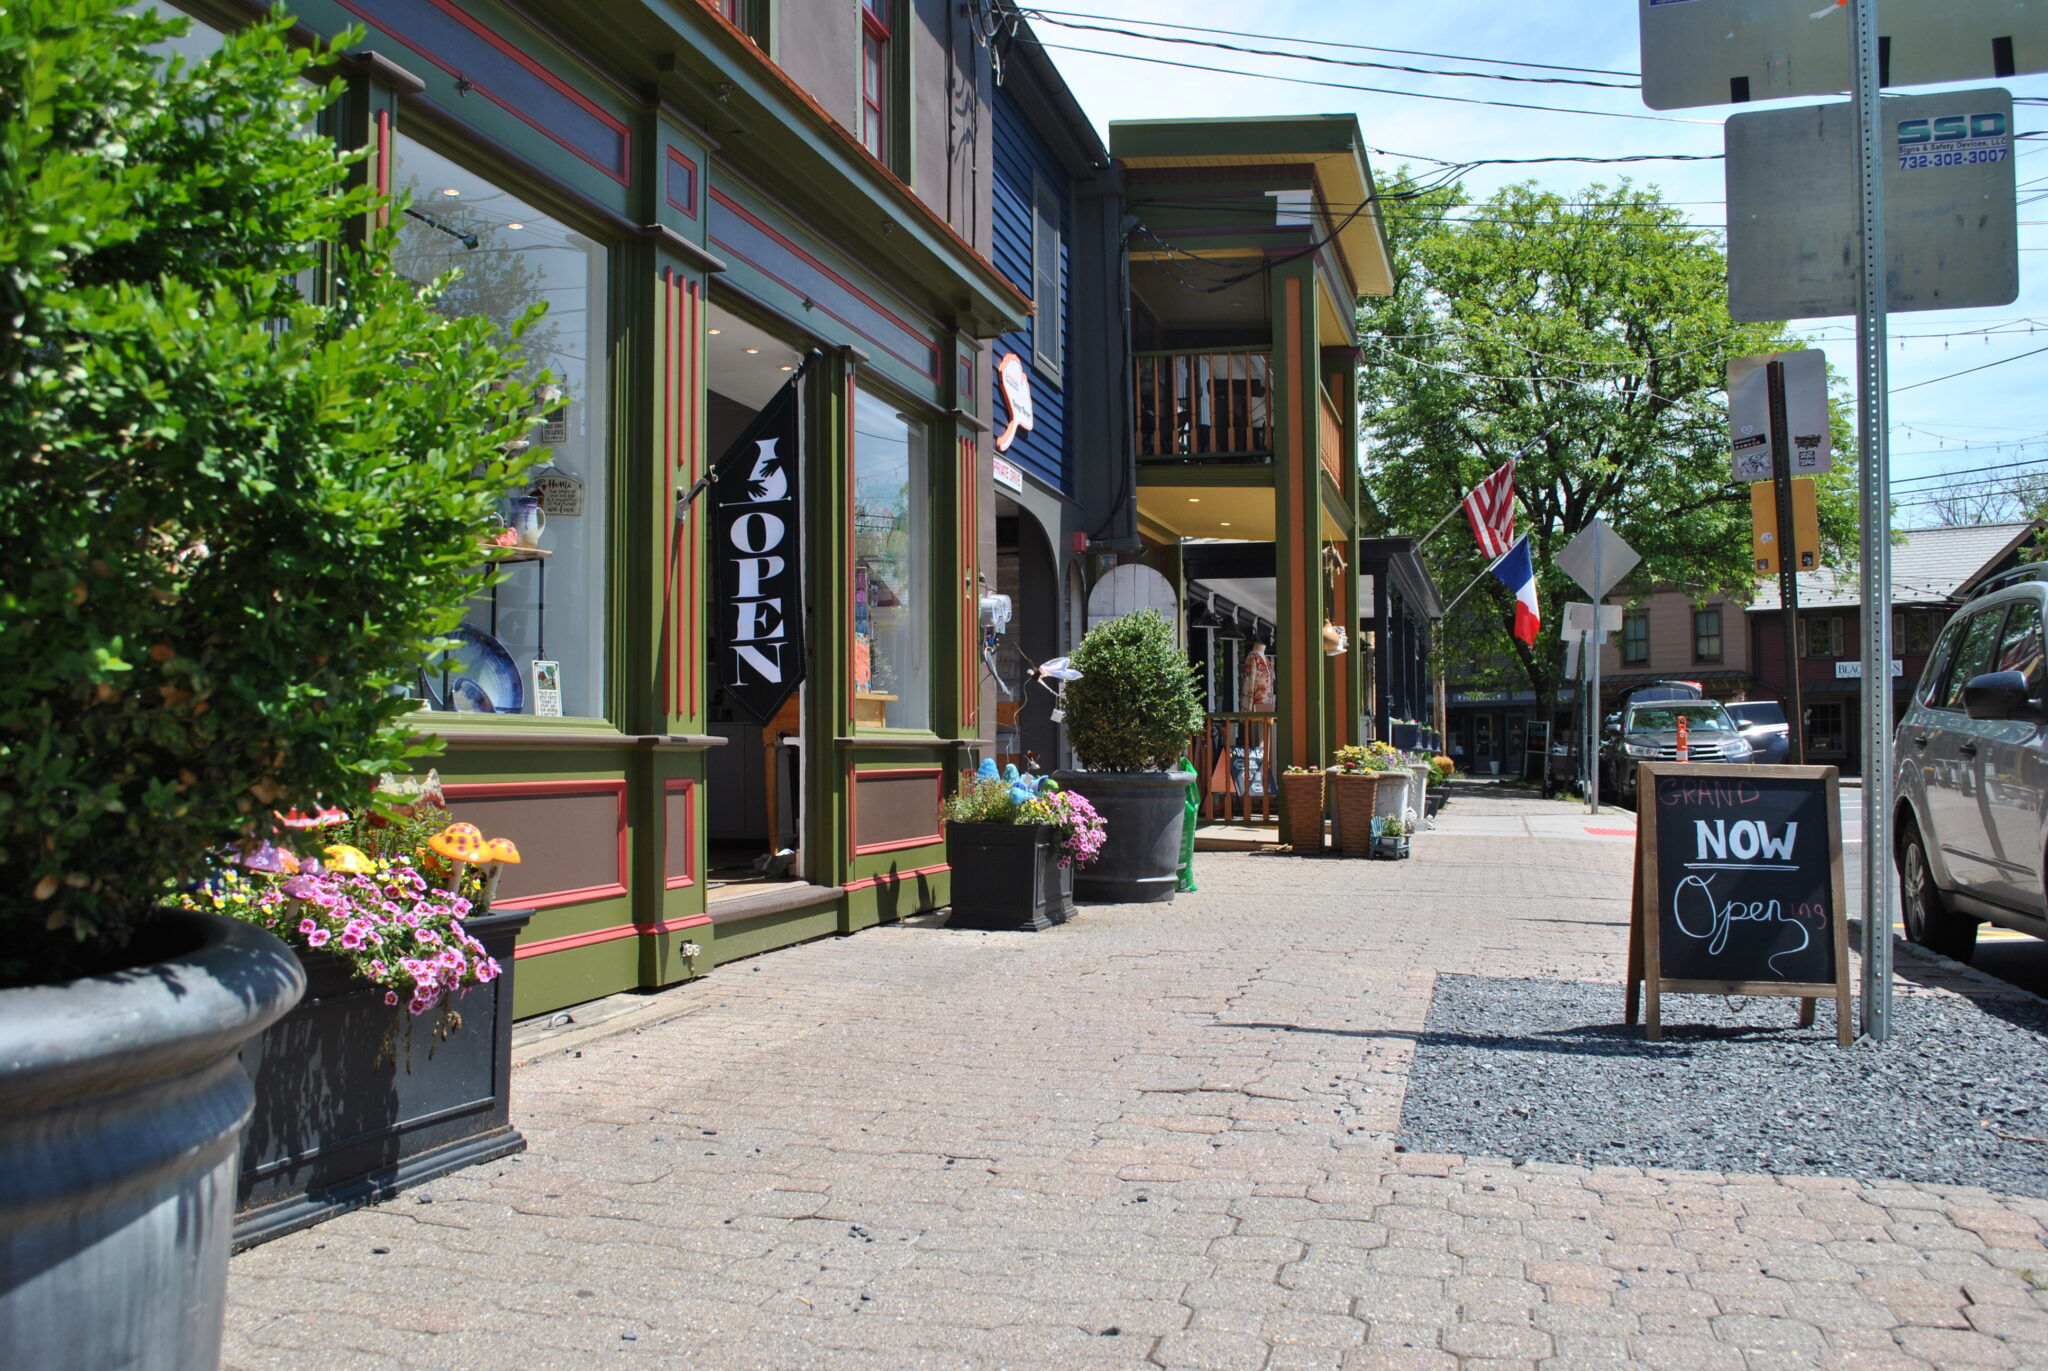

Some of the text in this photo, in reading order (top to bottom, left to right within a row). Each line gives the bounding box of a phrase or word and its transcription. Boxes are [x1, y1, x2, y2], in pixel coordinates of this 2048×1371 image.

[1898, 113, 2005, 144] SSD
[1899, 144, 1920, 154] Signs
[1930, 142, 1954, 151] Safety
[729, 511, 789, 686] OPEN
[1657, 777, 1760, 809] GRAND
[1693, 819, 1799, 861] NOW
